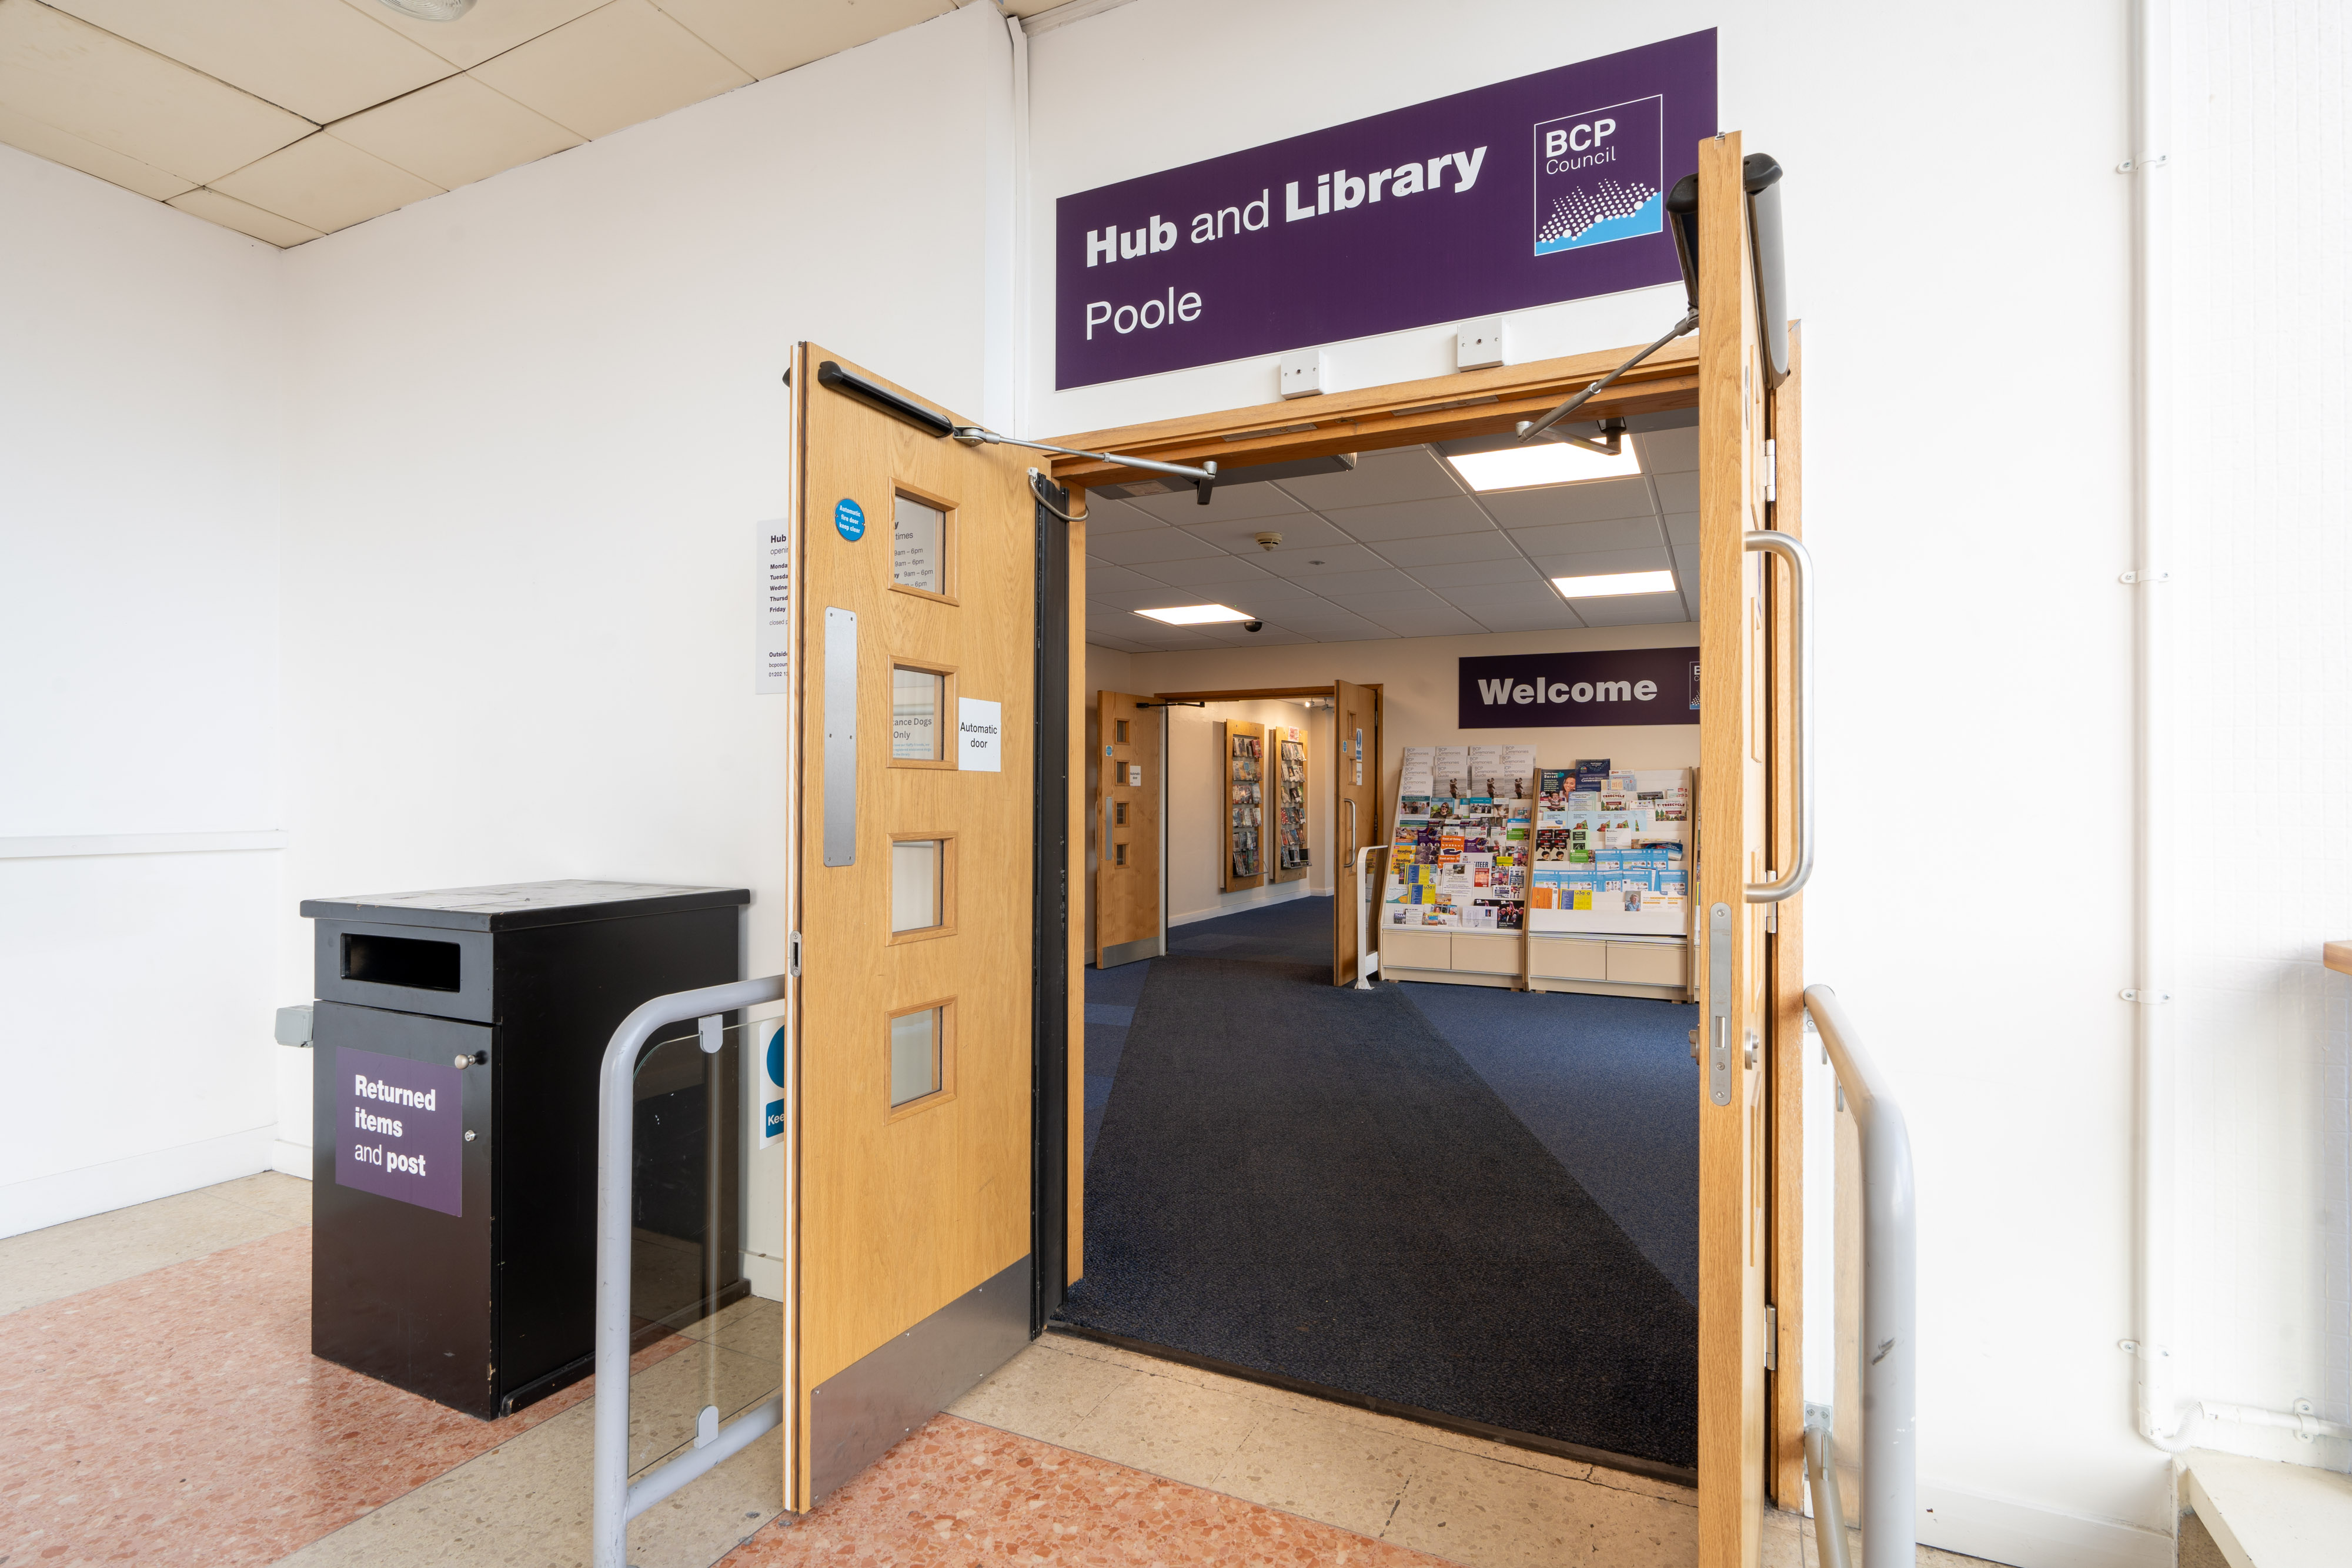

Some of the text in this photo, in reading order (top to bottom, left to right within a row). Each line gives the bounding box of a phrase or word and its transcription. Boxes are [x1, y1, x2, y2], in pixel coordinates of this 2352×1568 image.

[1545, 118, 1616, 158] BCP
[1546, 145, 1616, 175] Council
[1087, 146, 1487, 267] Hub and Library
[1087, 287, 1201, 340] Poole
[840, 505, 860, 517] Automatic
[839, 522, 849, 531] keep
[771, 534, 786, 543] Hub
[1478, 677, 1657, 704] Welcome
[914, 718, 932, 727] Dogs
[960, 722, 997, 734] Automatic
[894, 731, 911, 740] Only
[971, 738, 988, 748] door
[356, 1075, 435, 1111] Returned
[356, 1107, 402, 1138] items
[768, 1113, 784, 1126] Kee
[355, 1145, 426, 1176] and post
